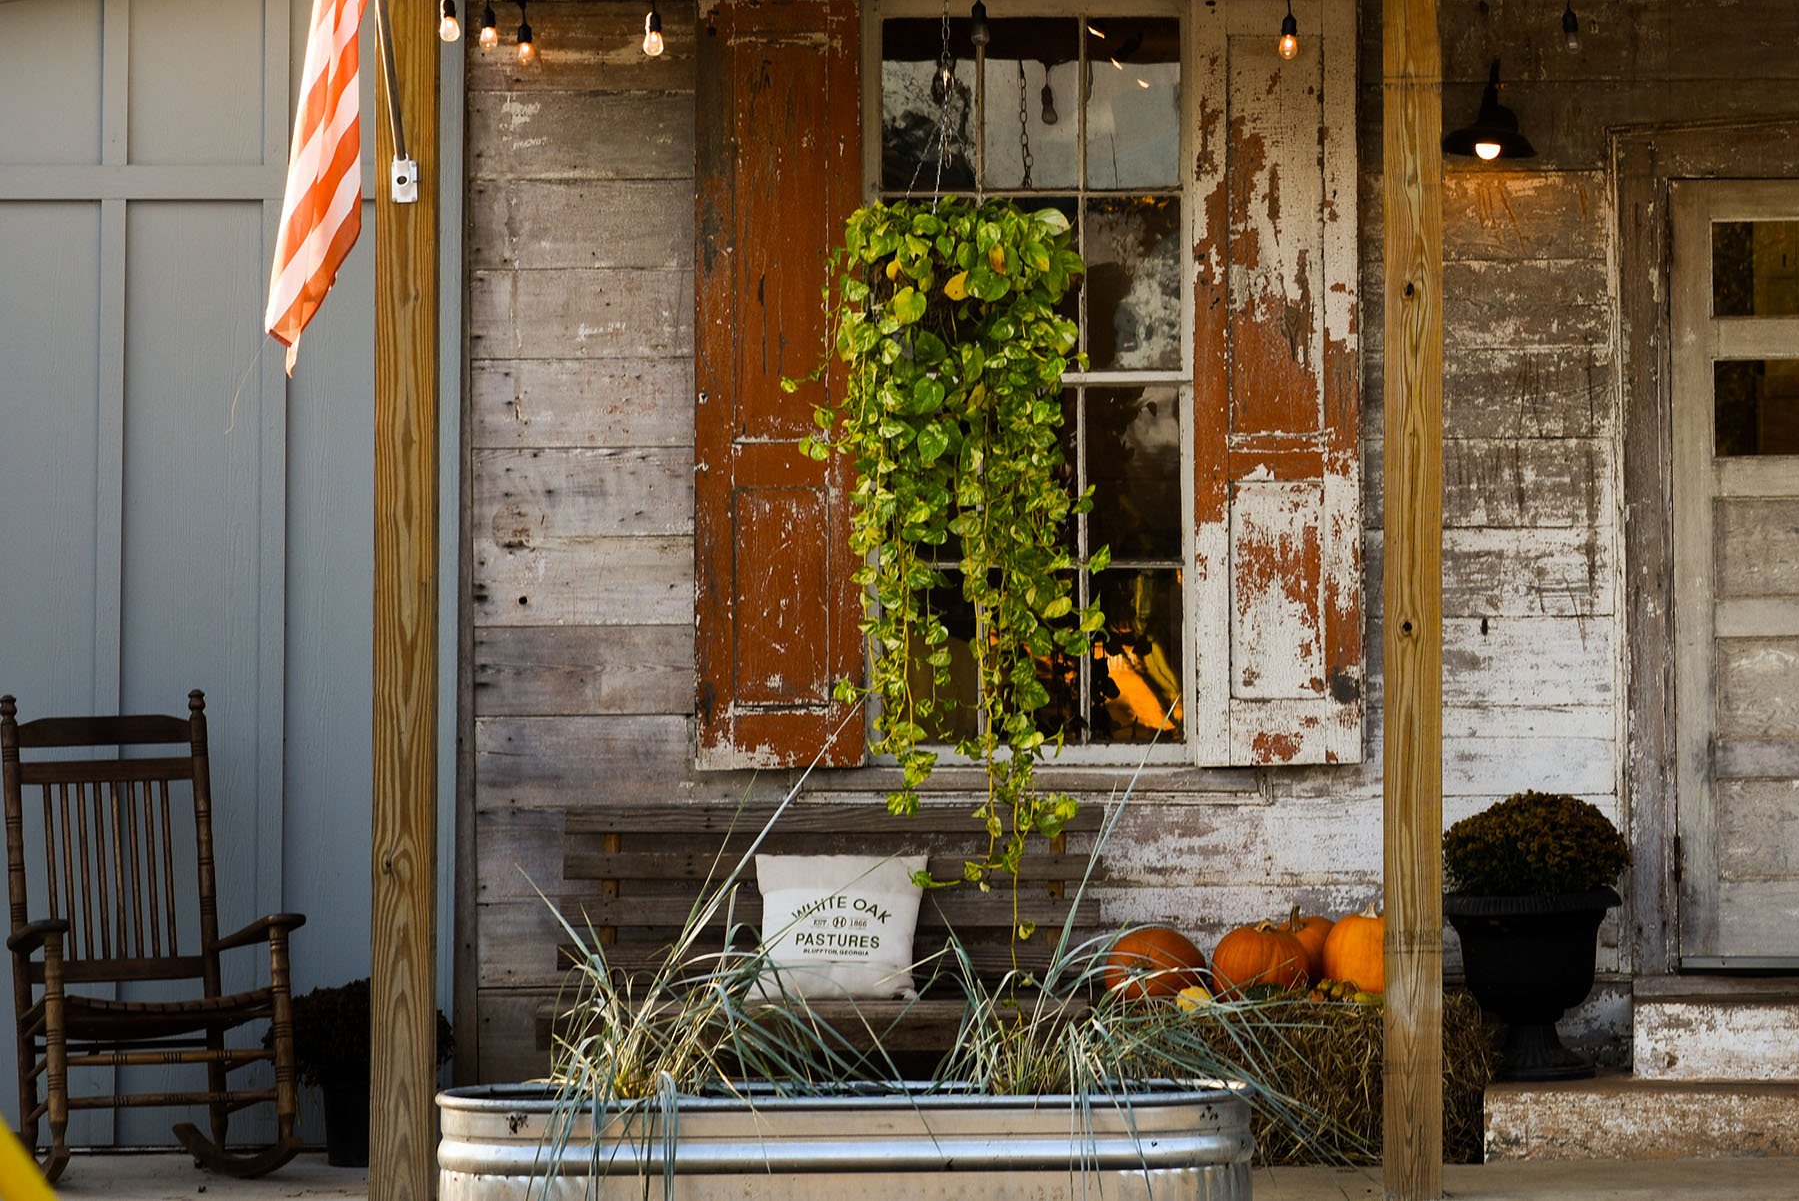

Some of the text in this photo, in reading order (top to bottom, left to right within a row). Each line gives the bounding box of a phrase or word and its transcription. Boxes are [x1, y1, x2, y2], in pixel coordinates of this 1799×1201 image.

[853, 898, 892, 925] OAK
[795, 932, 880, 949] PASTURES
[839, 949, 869, 957] GEORGIA
